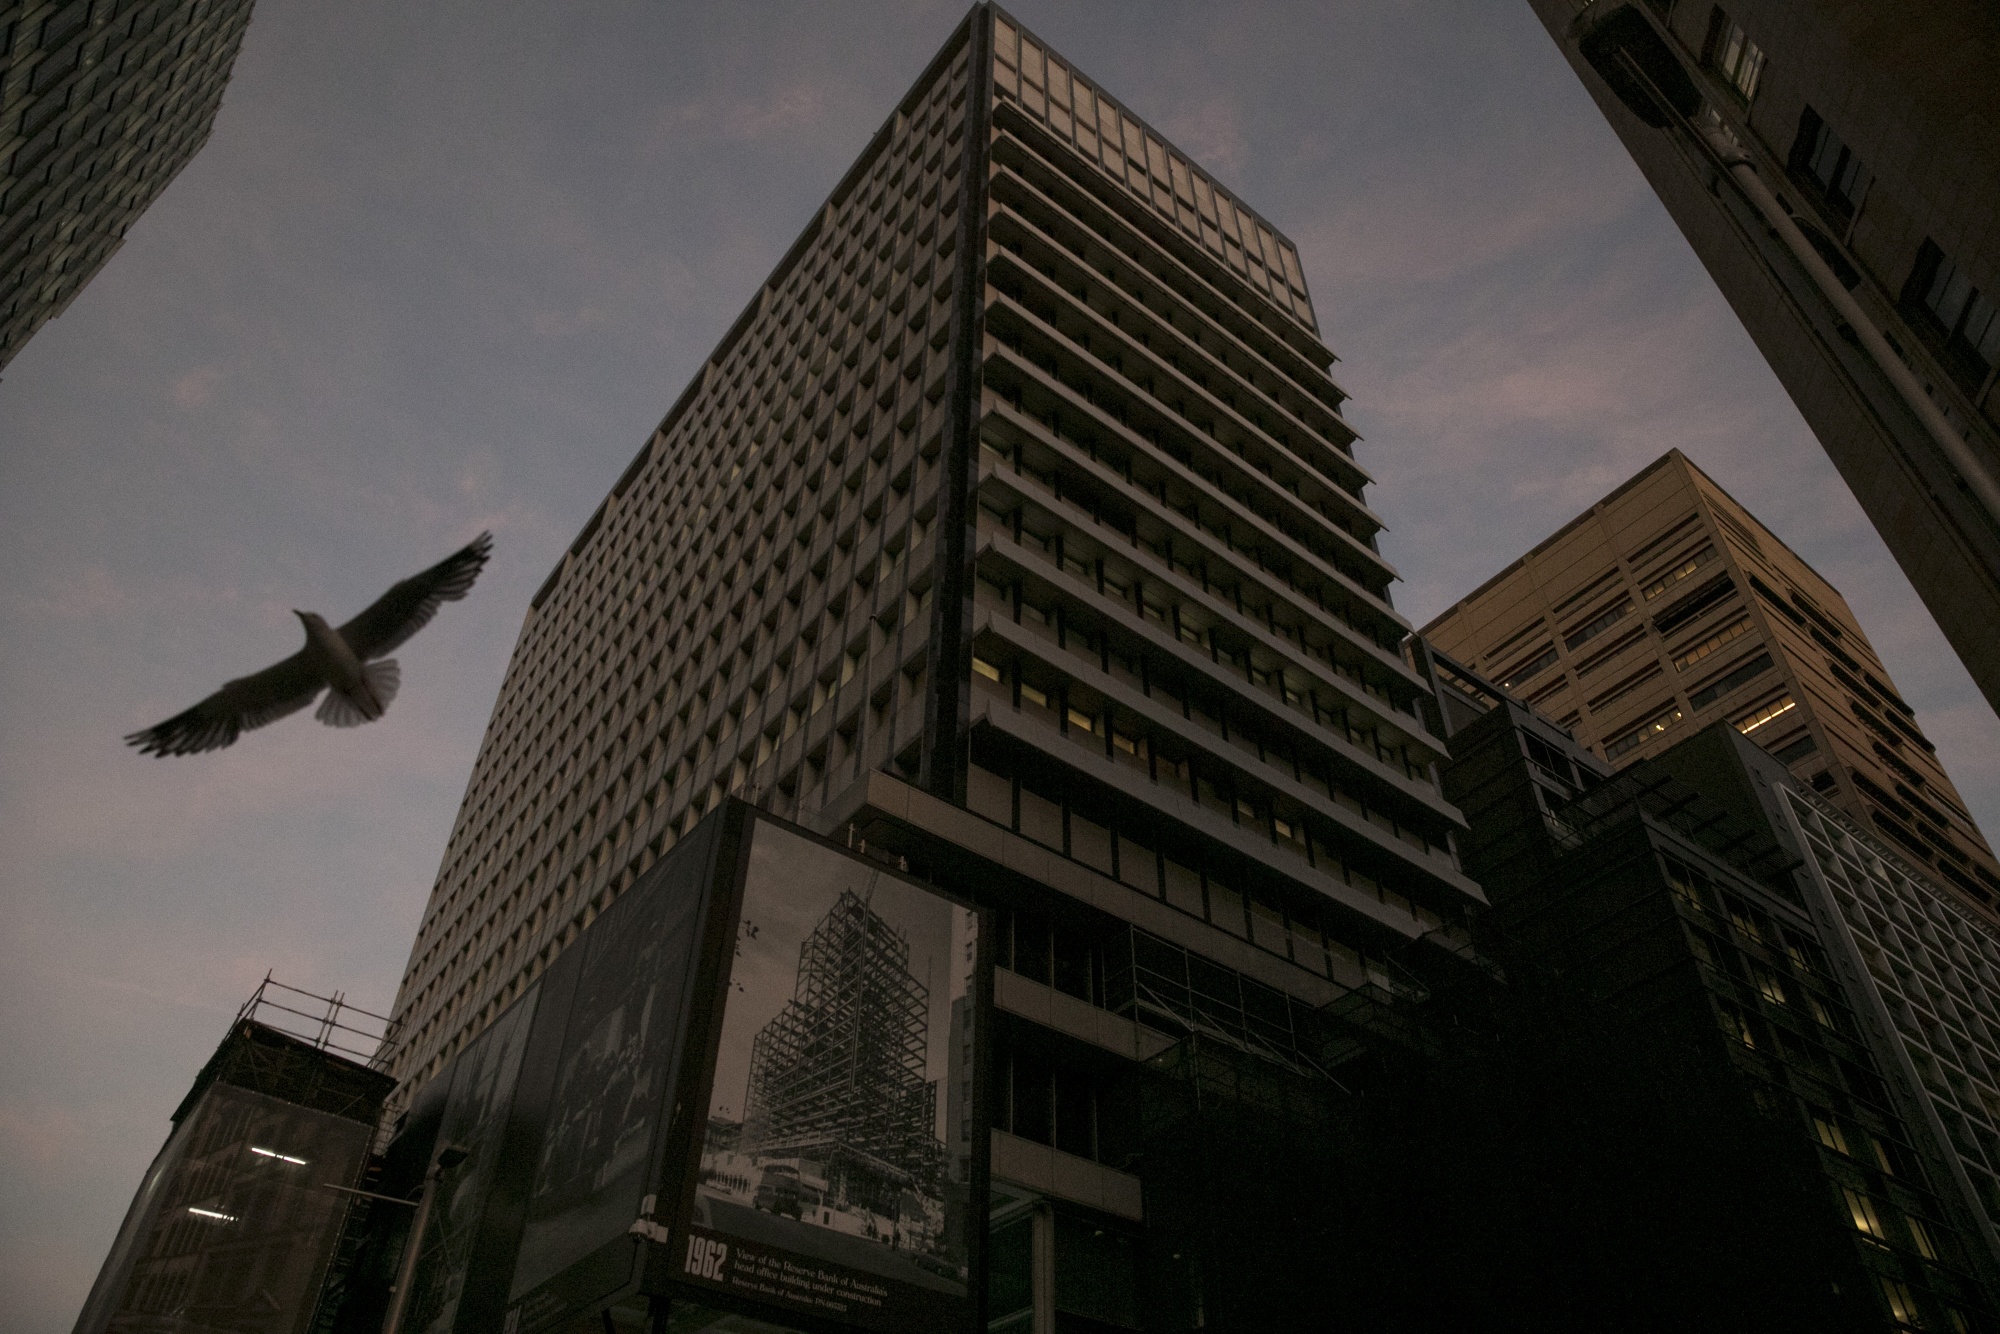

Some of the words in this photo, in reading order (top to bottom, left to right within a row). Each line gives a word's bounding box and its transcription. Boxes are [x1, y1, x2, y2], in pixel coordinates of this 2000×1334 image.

[685, 1234, 727, 1282] 1962
[736, 1247, 755, 1261] View
[758, 1255, 768, 1265] of
[768, 1258, 782, 1269] the
[783, 1260, 816, 1278] Reserve
[817, 1269, 838, 1284] Bank
[840, 1277, 849, 1286] of
[850, 1279, 888, 1297] Australia's
[732, 1276, 758, 1290] Reserve
[759, 1283, 776, 1294] Bank
[734, 1260, 754, 1273] head
[756, 1267, 778, 1280] office
[780, 1272, 810, 1290] building
[812, 1282, 834, 1295] under
[836, 1289, 882, 1307] construction
